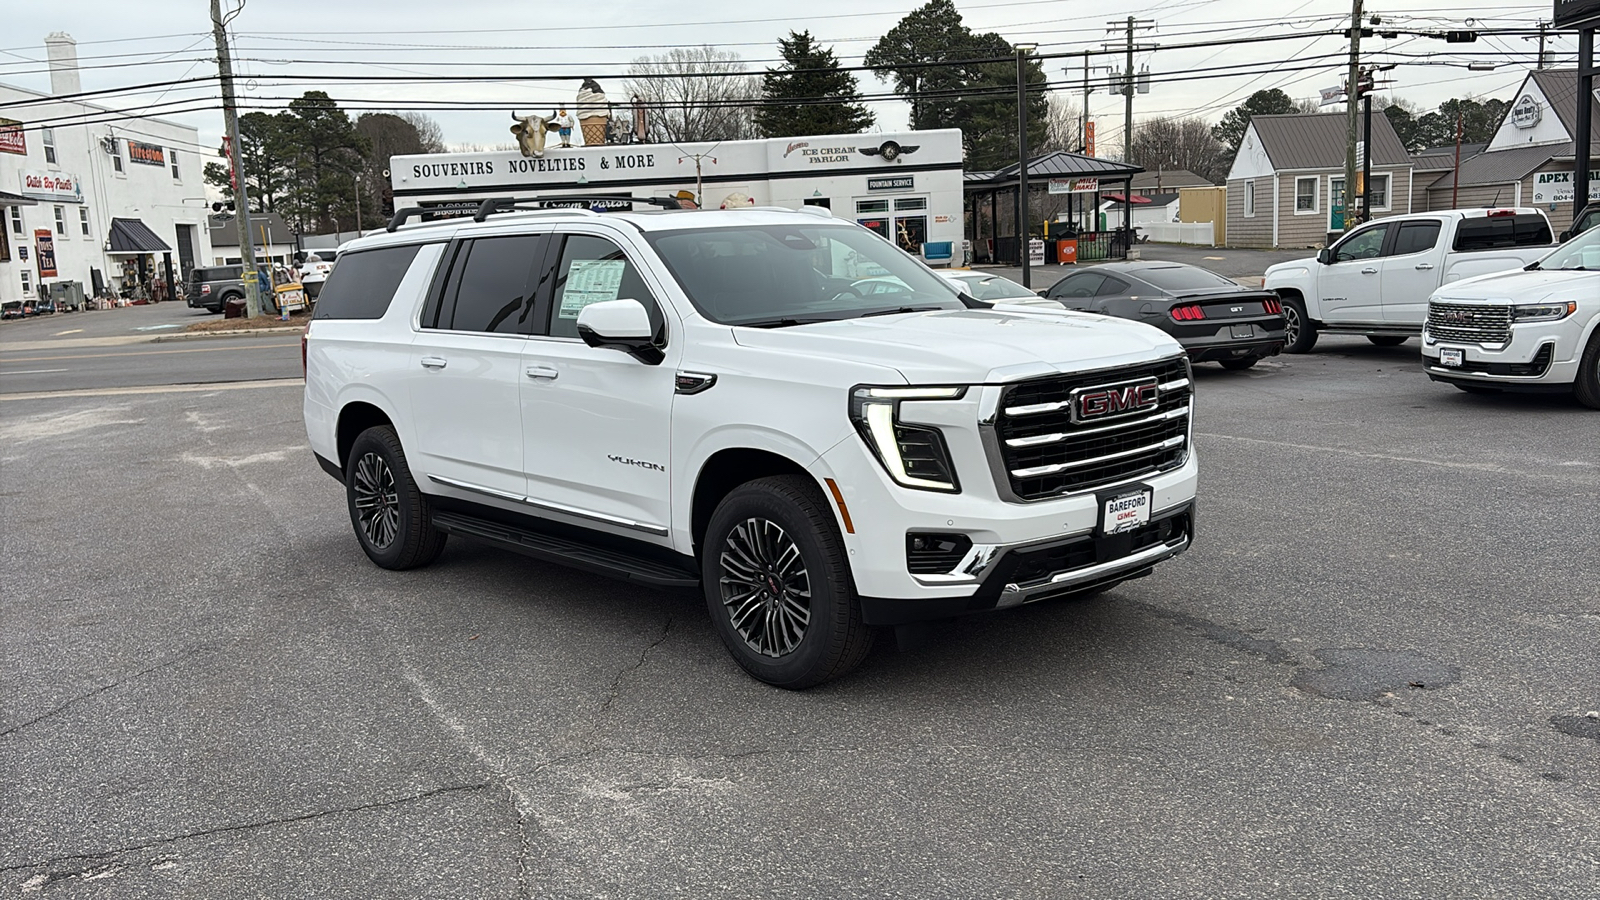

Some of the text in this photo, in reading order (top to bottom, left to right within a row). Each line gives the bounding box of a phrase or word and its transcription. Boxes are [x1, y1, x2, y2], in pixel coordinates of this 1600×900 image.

[129, 142, 164, 161] Firestone
[801, 145, 856, 157] ICE CREAM
[809, 155, 849, 164] PARLOR
[412, 154, 656, 178] SOUVENIRS NOVELTIES & MORE
[25, 175, 73, 192] Dutch Boy Paints
[869, 178, 912, 189] FOUNTAIN SERVICE
[1538, 172, 1570, 184] APEX
[1074, 183, 1098, 191] SHAKES
[543, 199, 630, 209] Cream Parlor
[42, 256, 54, 268] TEA
[1444, 311, 1472, 322] GMC
[1080, 383, 1158, 418] GMC
[607, 454, 666, 473] YUKON
[1109, 496, 1147, 514] BAREFORD
[1117, 510, 1137, 521] GMC
